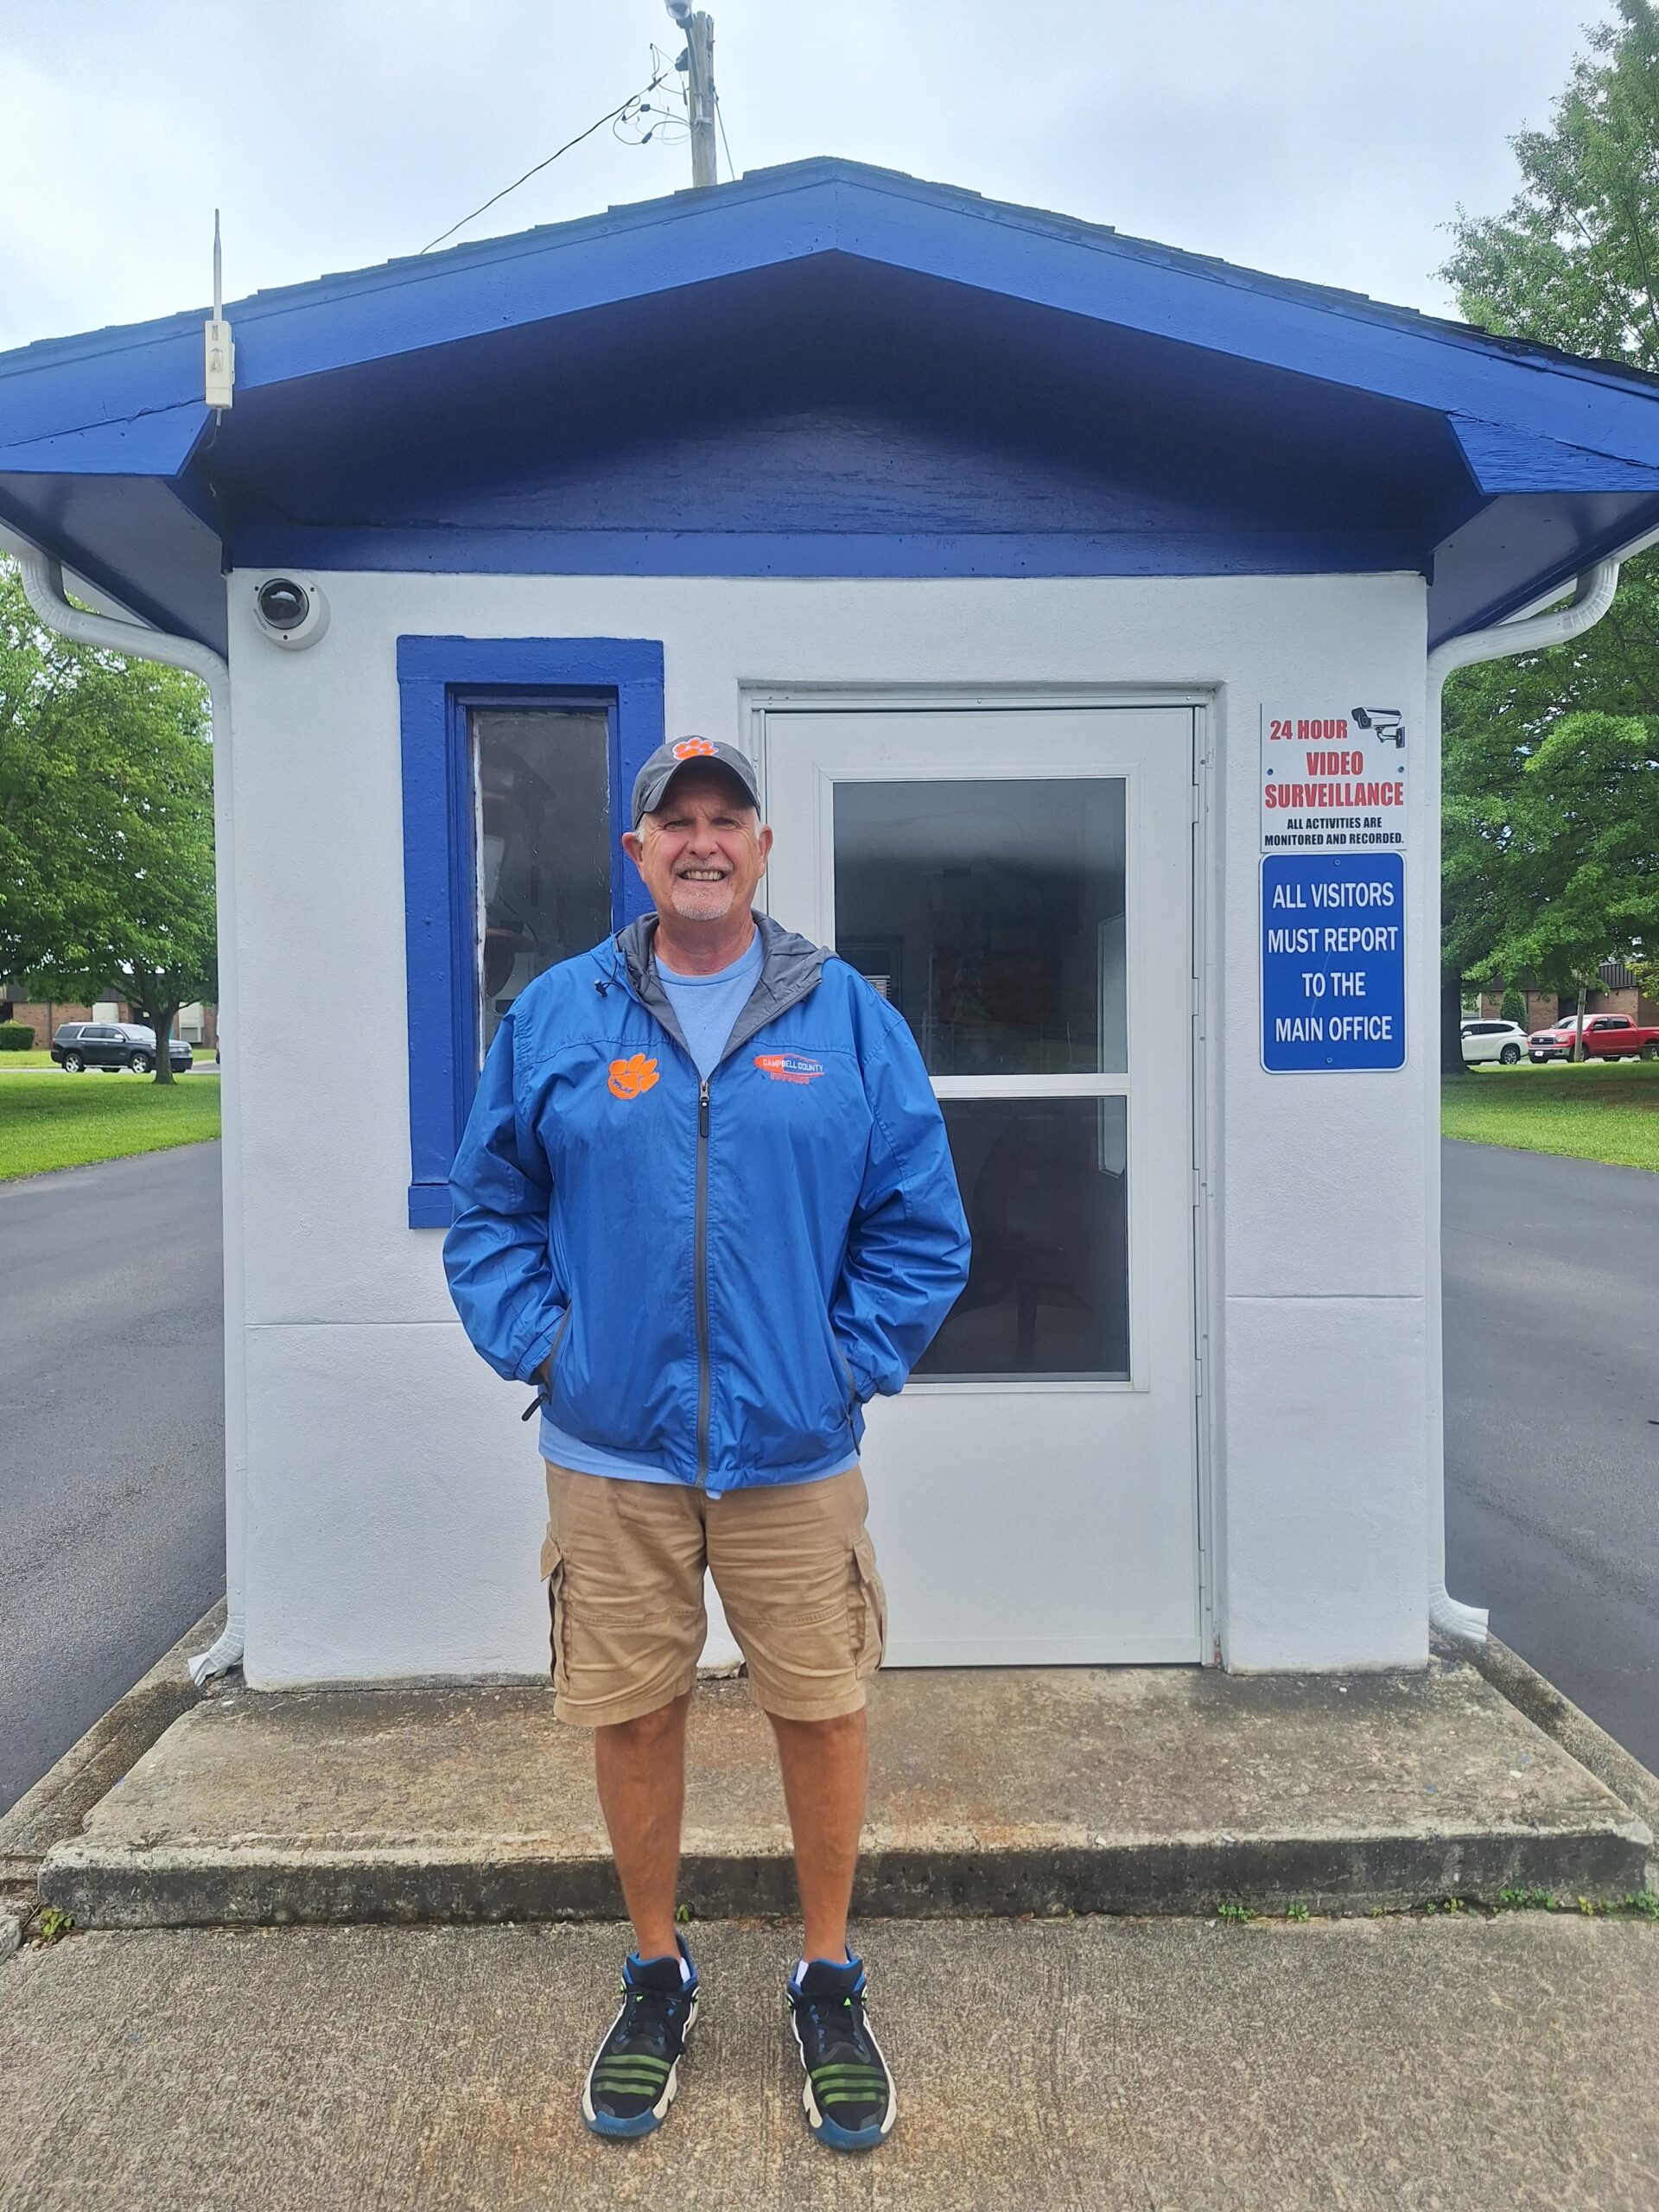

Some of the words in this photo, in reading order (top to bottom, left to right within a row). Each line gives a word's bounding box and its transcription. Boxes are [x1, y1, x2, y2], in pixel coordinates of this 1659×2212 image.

[1270, 720, 1293, 740] 24
[1297, 720, 1347, 739] HOUR
[1306, 751, 1363, 776] VIDEO
[1265, 782, 1404, 809] SURVEILLANCE
[1287, 818, 1303, 830] ALL
[1306, 817, 1361, 830] ACTIVITIES
[1363, 817, 1382, 828] ARE
[1264, 834, 1324, 846] MONITORED
[1325, 833, 1346, 845] AND
[1349, 833, 1404, 844] RECORDED.
[1272, 884, 1306, 908] ALL
[1311, 882, 1395, 907] VISITORS
[1268, 928, 1319, 953] MUST
[1325, 926, 1398, 951] REPORT
[1302, 972, 1326, 996] TO
[1331, 972, 1366, 996] THE
[1275, 1017, 1323, 1042] MAIN
[1329, 1015, 1392, 1041] OFFICE
[762, 1058, 797, 1069] CAMPBELL
[798, 1062, 823, 1071] COUNTY
